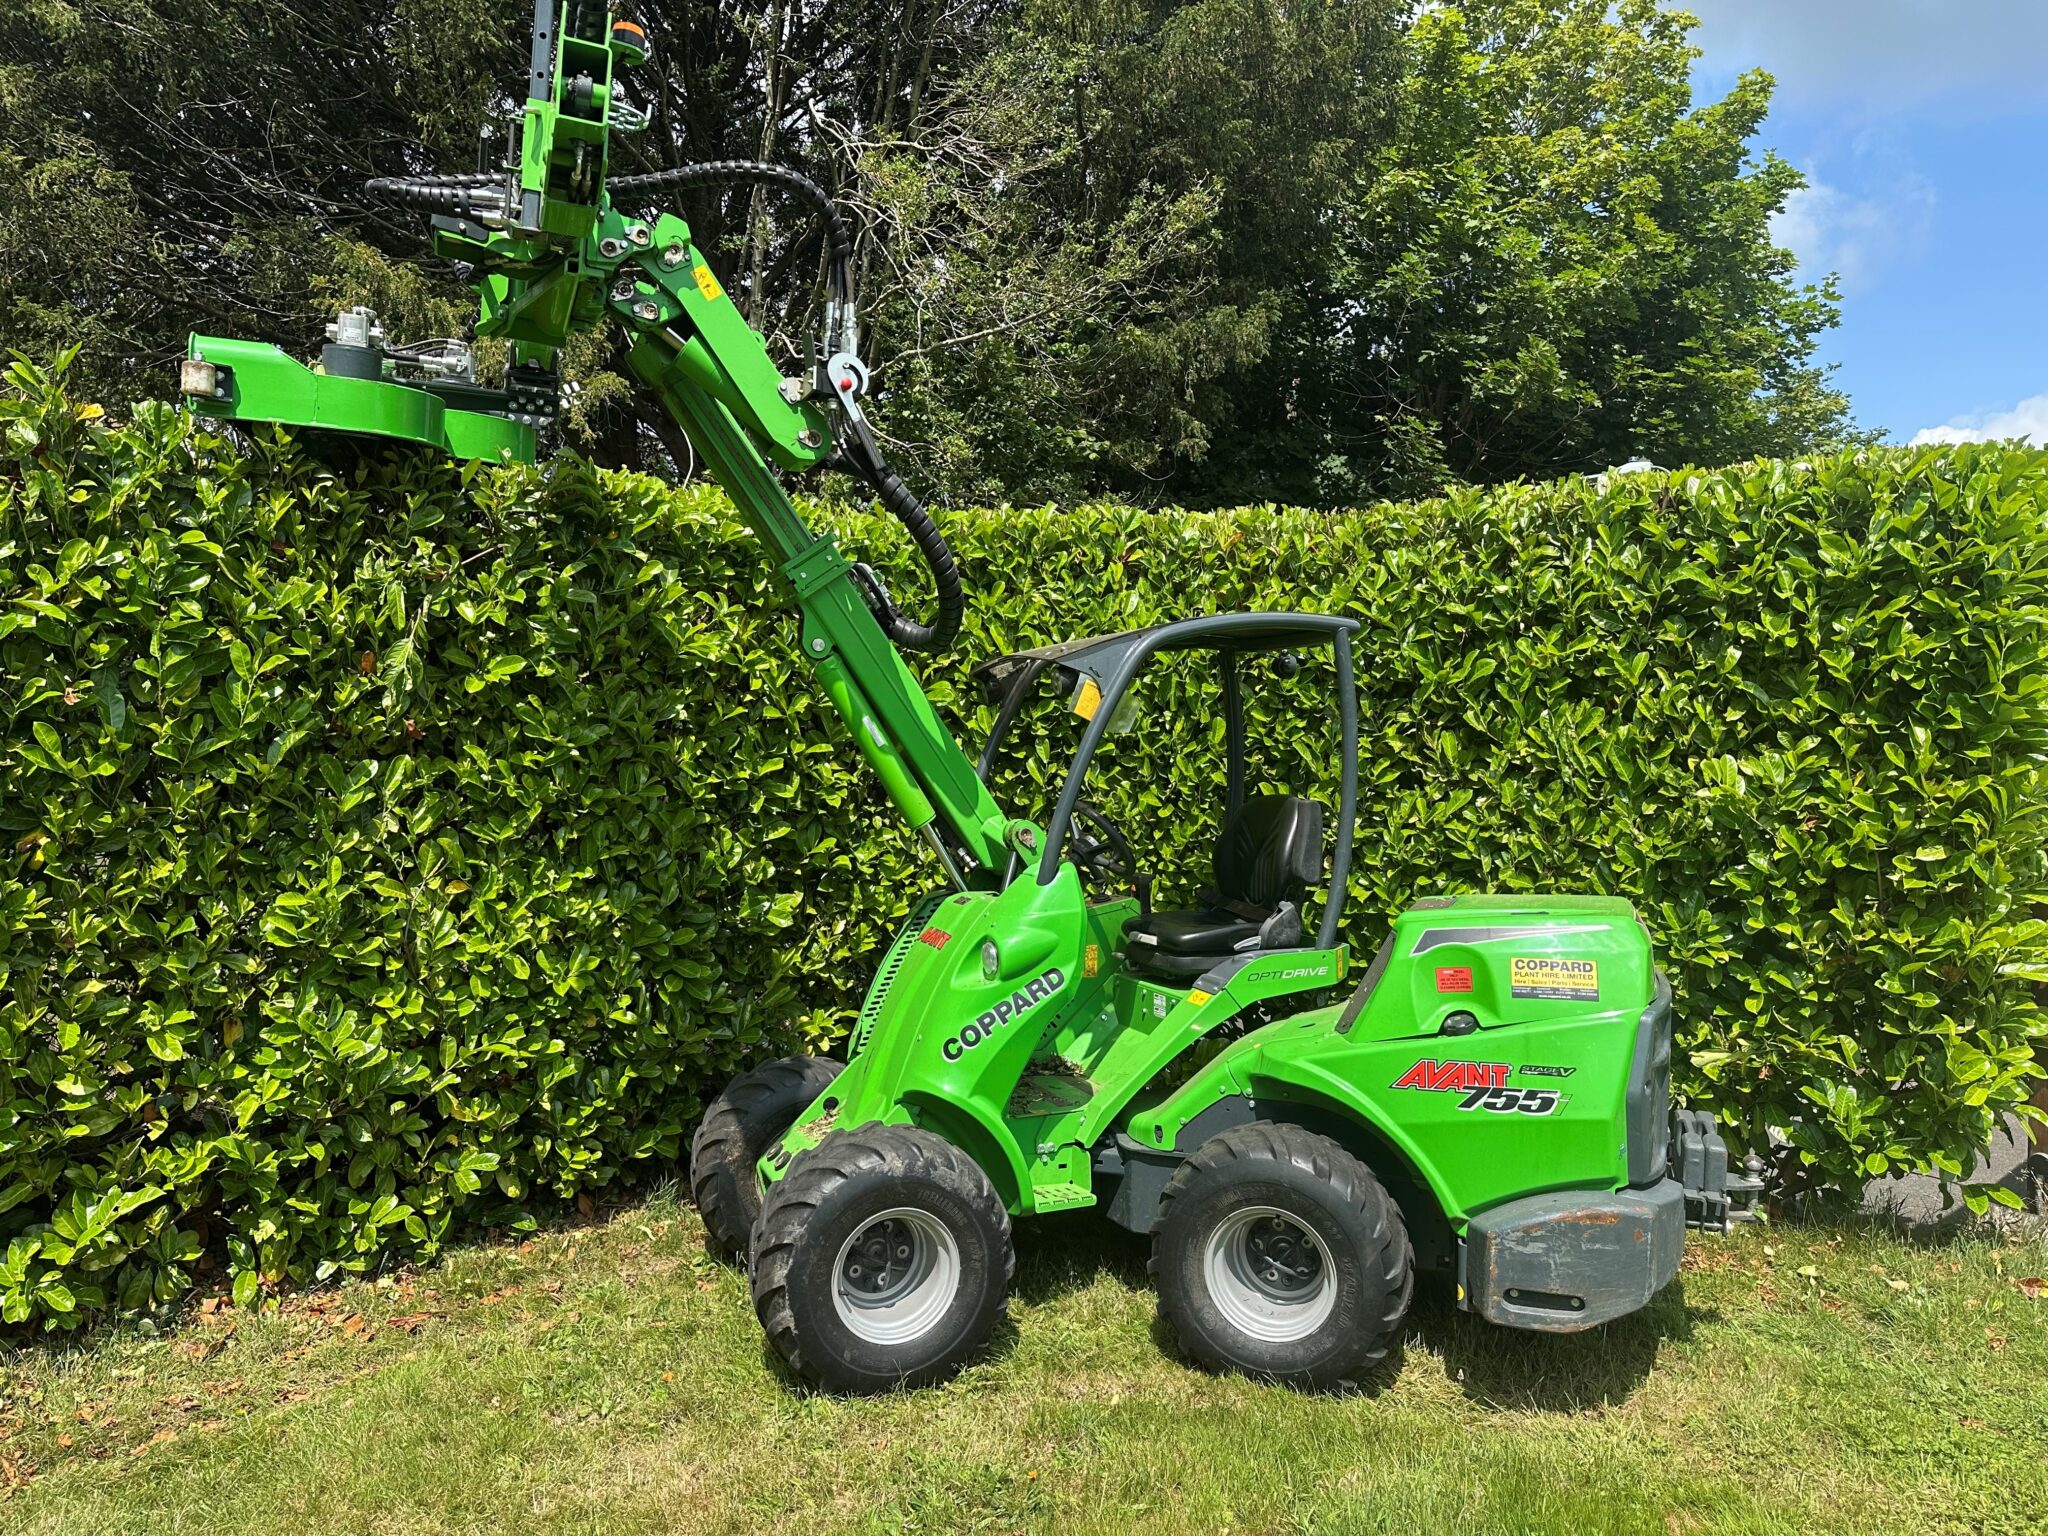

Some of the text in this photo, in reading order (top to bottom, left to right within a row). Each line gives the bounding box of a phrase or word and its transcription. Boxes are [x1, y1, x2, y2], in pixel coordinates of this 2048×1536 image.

[1247, 966, 1329, 982] OPTIDRIVE
[1515, 959, 1594, 973] COPPARD
[1562, 973, 1594, 981] LIMITED
[942, 967, 1065, 1063] COPPARD
[1392, 1059, 1512, 1091] AVANT
